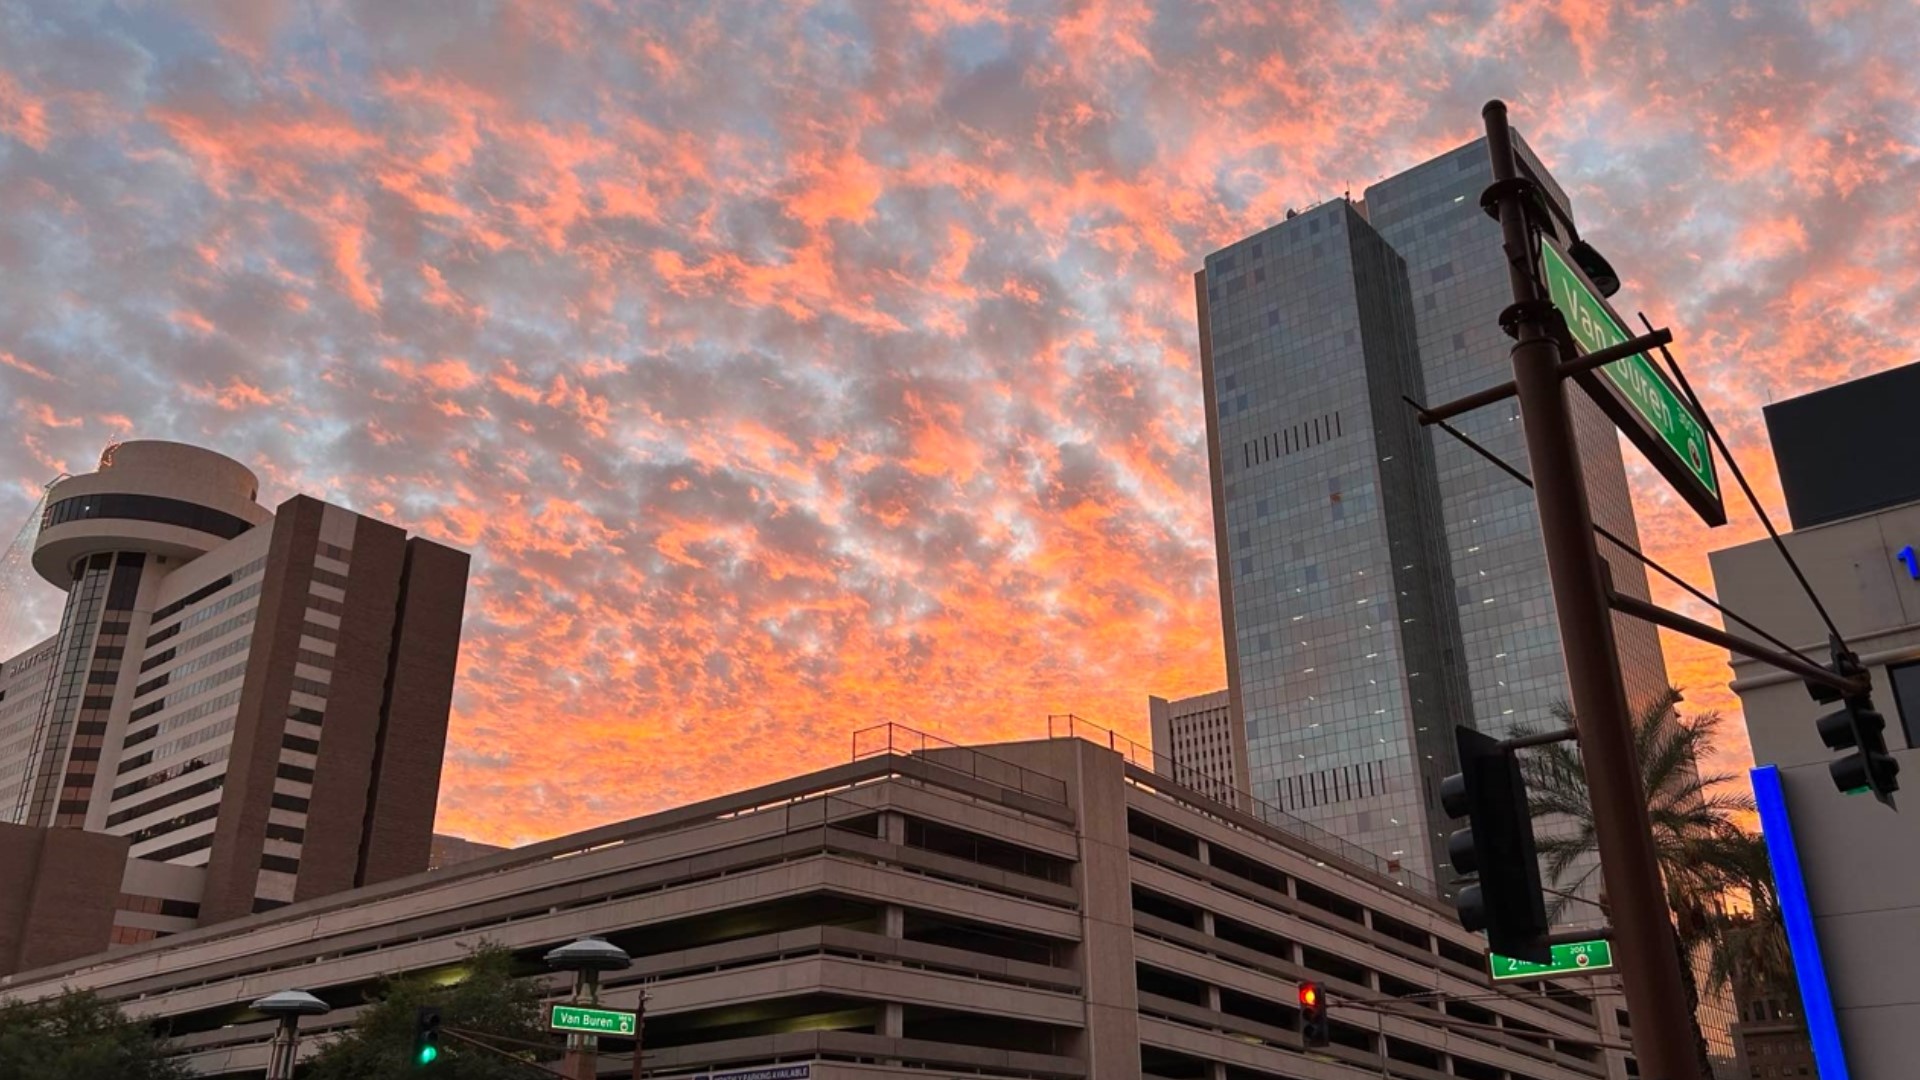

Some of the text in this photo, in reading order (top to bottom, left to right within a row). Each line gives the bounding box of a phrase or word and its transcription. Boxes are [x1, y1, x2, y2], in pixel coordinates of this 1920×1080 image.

[1562, 277, 1606, 350] Van
[560, 1012, 580, 1025] Van
[583, 1014, 613, 1028] Buren
